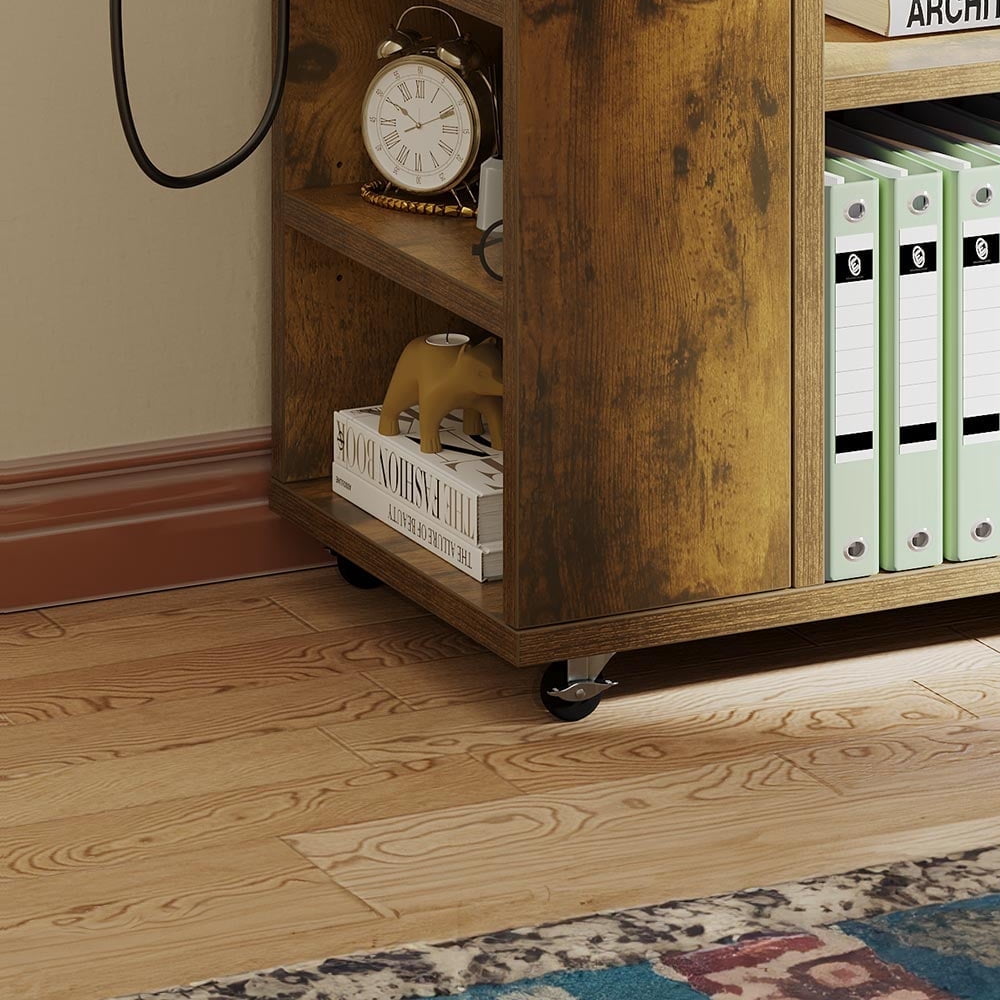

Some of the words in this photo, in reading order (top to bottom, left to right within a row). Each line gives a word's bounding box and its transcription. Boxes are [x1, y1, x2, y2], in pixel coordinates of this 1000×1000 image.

[337, 420, 375, 480] BOOK
[378, 445, 440, 519] FASHION
[387, 503, 415, 533] BEAUTY
[444, 483, 474, 540] THE
[416, 522, 427, 541] OF
[428, 527, 455, 558] ALLURE
[457, 545, 473, 570] THE
